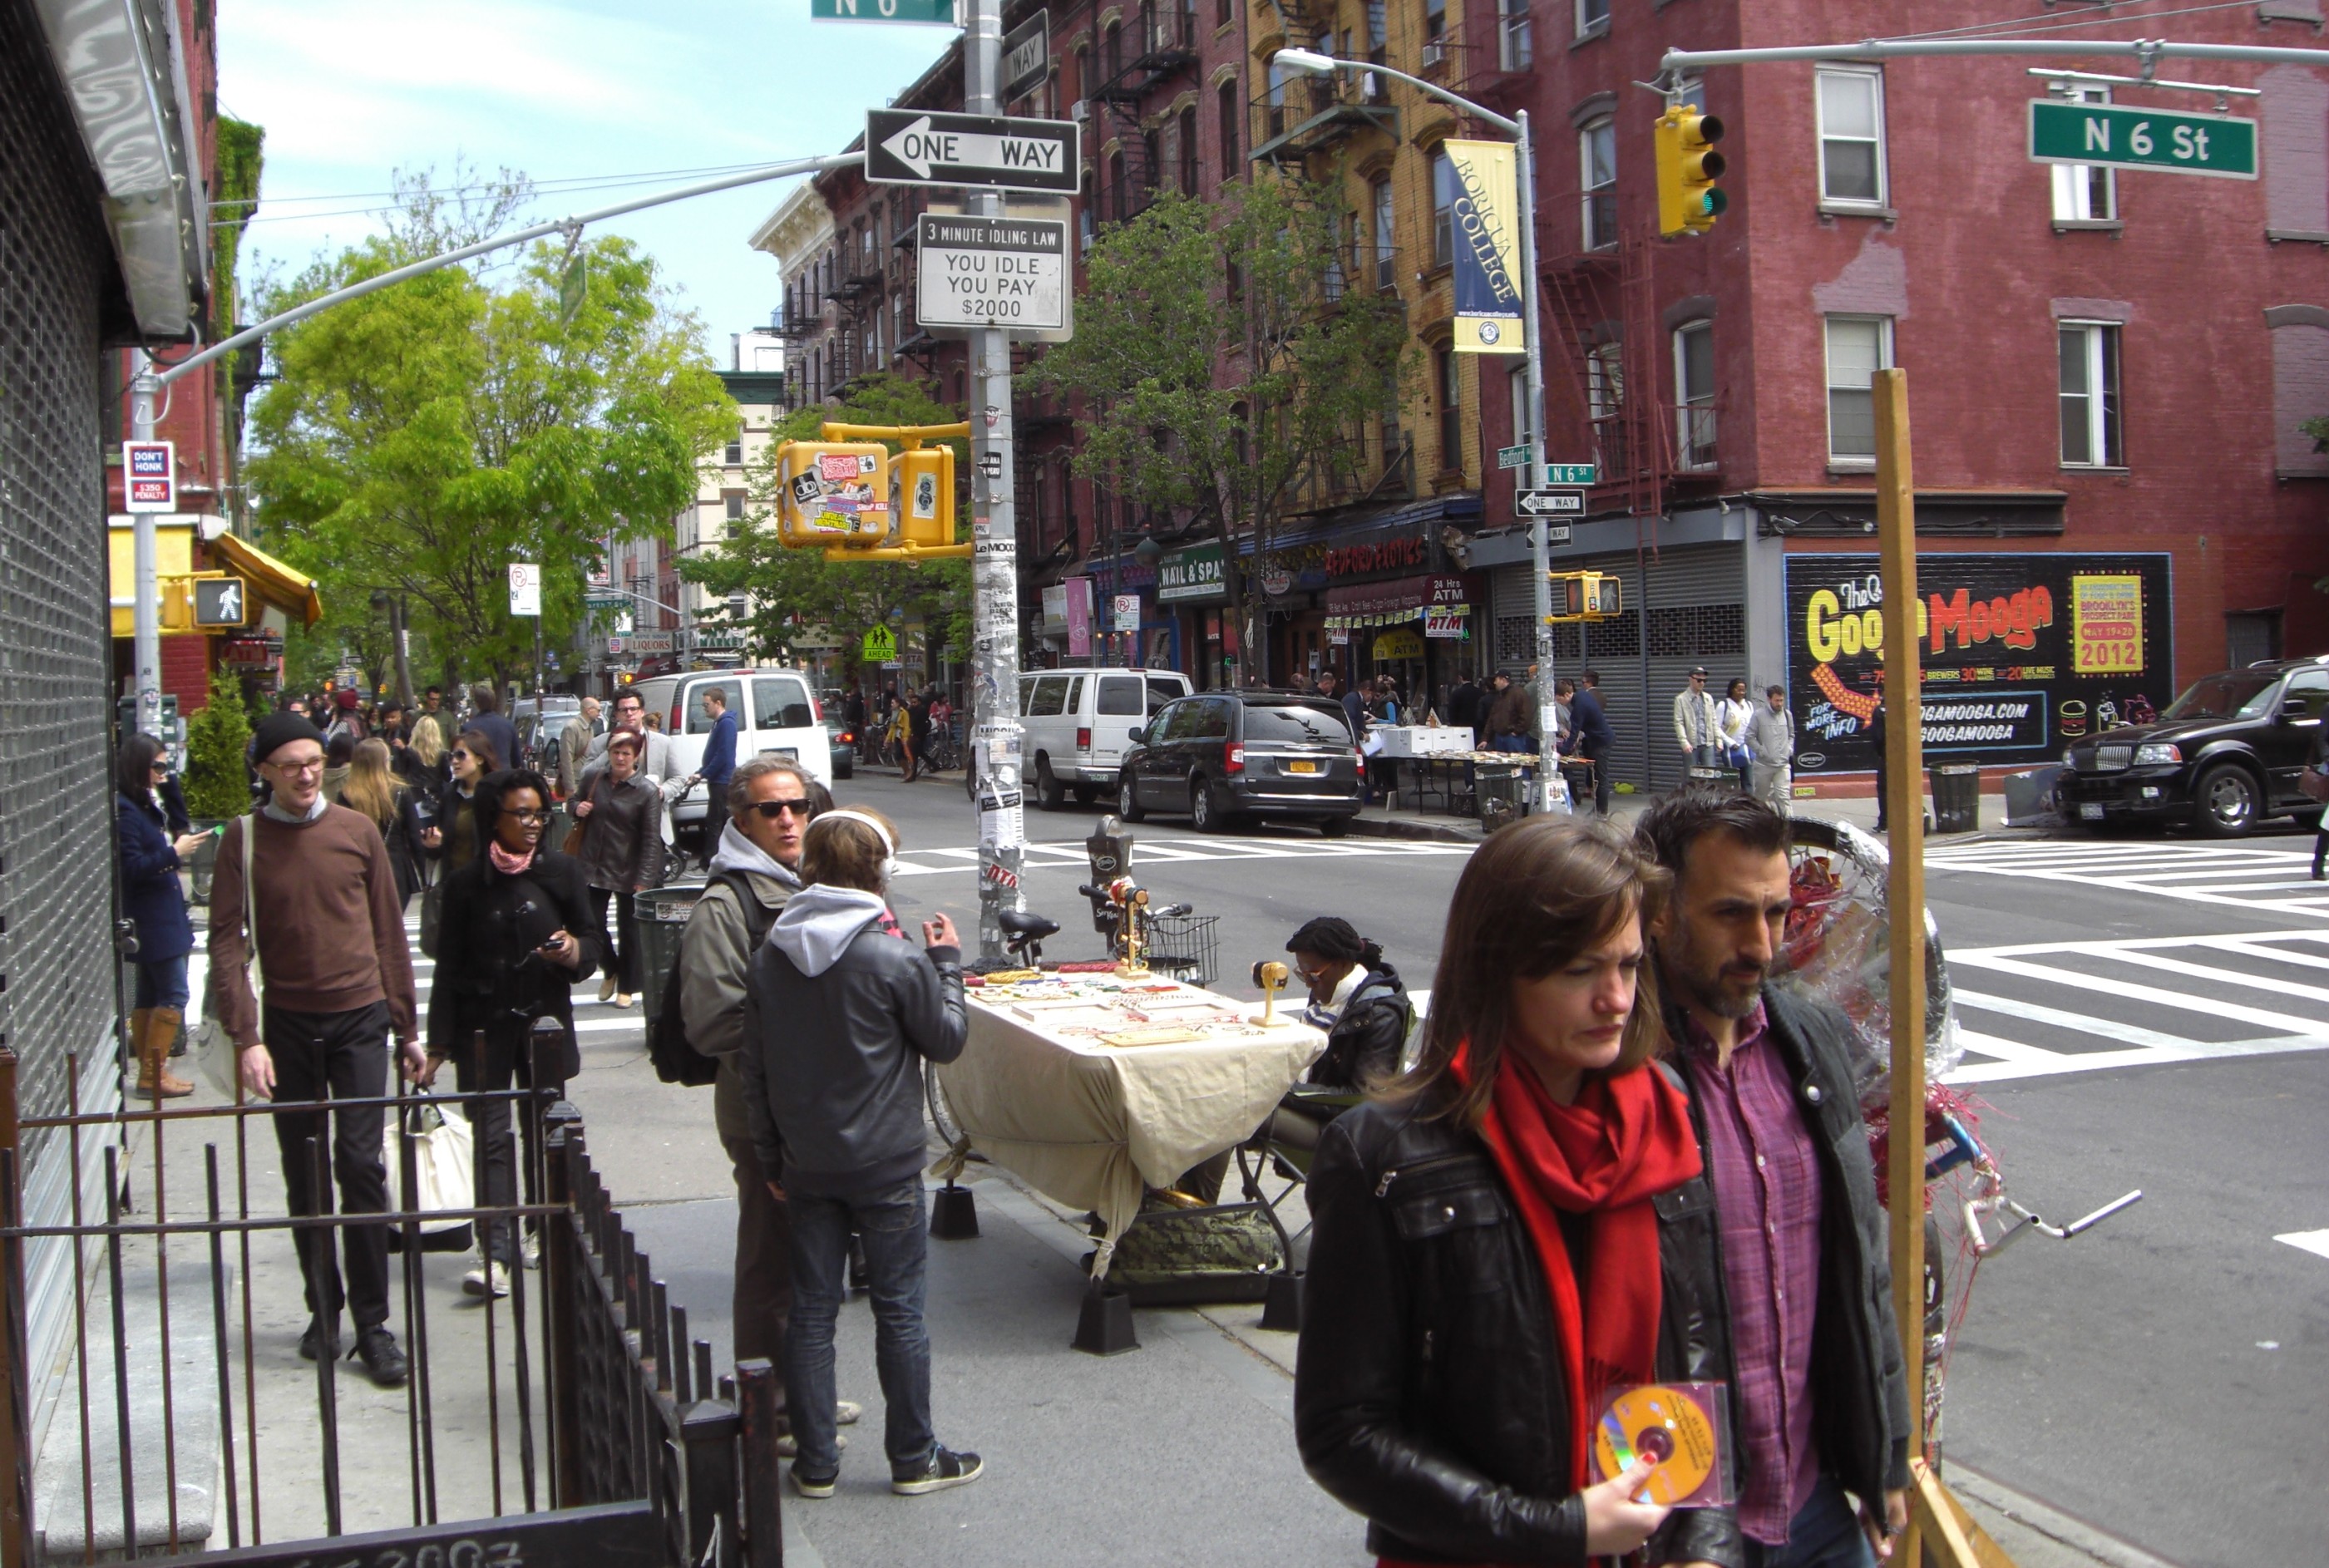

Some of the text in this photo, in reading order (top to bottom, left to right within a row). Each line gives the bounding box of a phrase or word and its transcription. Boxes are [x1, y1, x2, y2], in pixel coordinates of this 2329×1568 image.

[1013, 38, 1036, 77] WAY
[2085, 117, 2209, 160] N 6 St
[904, 134, 1058, 168] ONE WAY
[1457, 159, 1512, 260] BORICUA
[927, 224, 1056, 246] 3 MINUTE IDLING LAW
[1455, 197, 1514, 303] COLLEGE
[945, 254, 1039, 275] YOU IDLE
[948, 276, 1036, 296] YOU PAY
[962, 298, 1021, 318] $2000
[134, 451, 163, 461] DON'T
[1499, 450, 1525, 466] Bedford
[135, 462, 163, 471] HONK
[1553, 466, 1586, 481] N 6 St
[135, 491, 165, 499] PENALTY
[139, 484, 160, 492] $350
[1527, 497, 1575, 508] ONE WAY
[1552, 528, 1567, 539] WAY
[1375, 536, 1423, 570] EXOTICS
[1162, 560, 1221, 585] NAIL & SPA
[1434, 579, 1461, 589] 24 Hrs
[1433, 589, 1463, 601] ATM
[1840, 580, 1869, 609] The
[2080, 601, 2135, 610] BROOKLYN'S
[1428, 616, 1462, 630] ATM
[1929, 585, 2053, 655] Mooga
[2084, 628, 2103, 637] MAY
[632, 640, 670, 650] LIQUORS
[699, 638, 745, 648] MARKET
[1394, 643, 1419, 655] ATM
[867, 650, 891, 658] AHEAD
[2081, 642, 2137, 666] 2012
[1927, 671, 1960, 680] BREWERS
[1961, 668, 1976, 681] 30
[2007, 667, 2022, 681] 20
[2036, 666, 2055, 674] MUSIC
[1810, 702, 1832, 717] FOR
[1806, 711, 1838, 731] MORE
[1825, 717, 1857, 740] INFO
